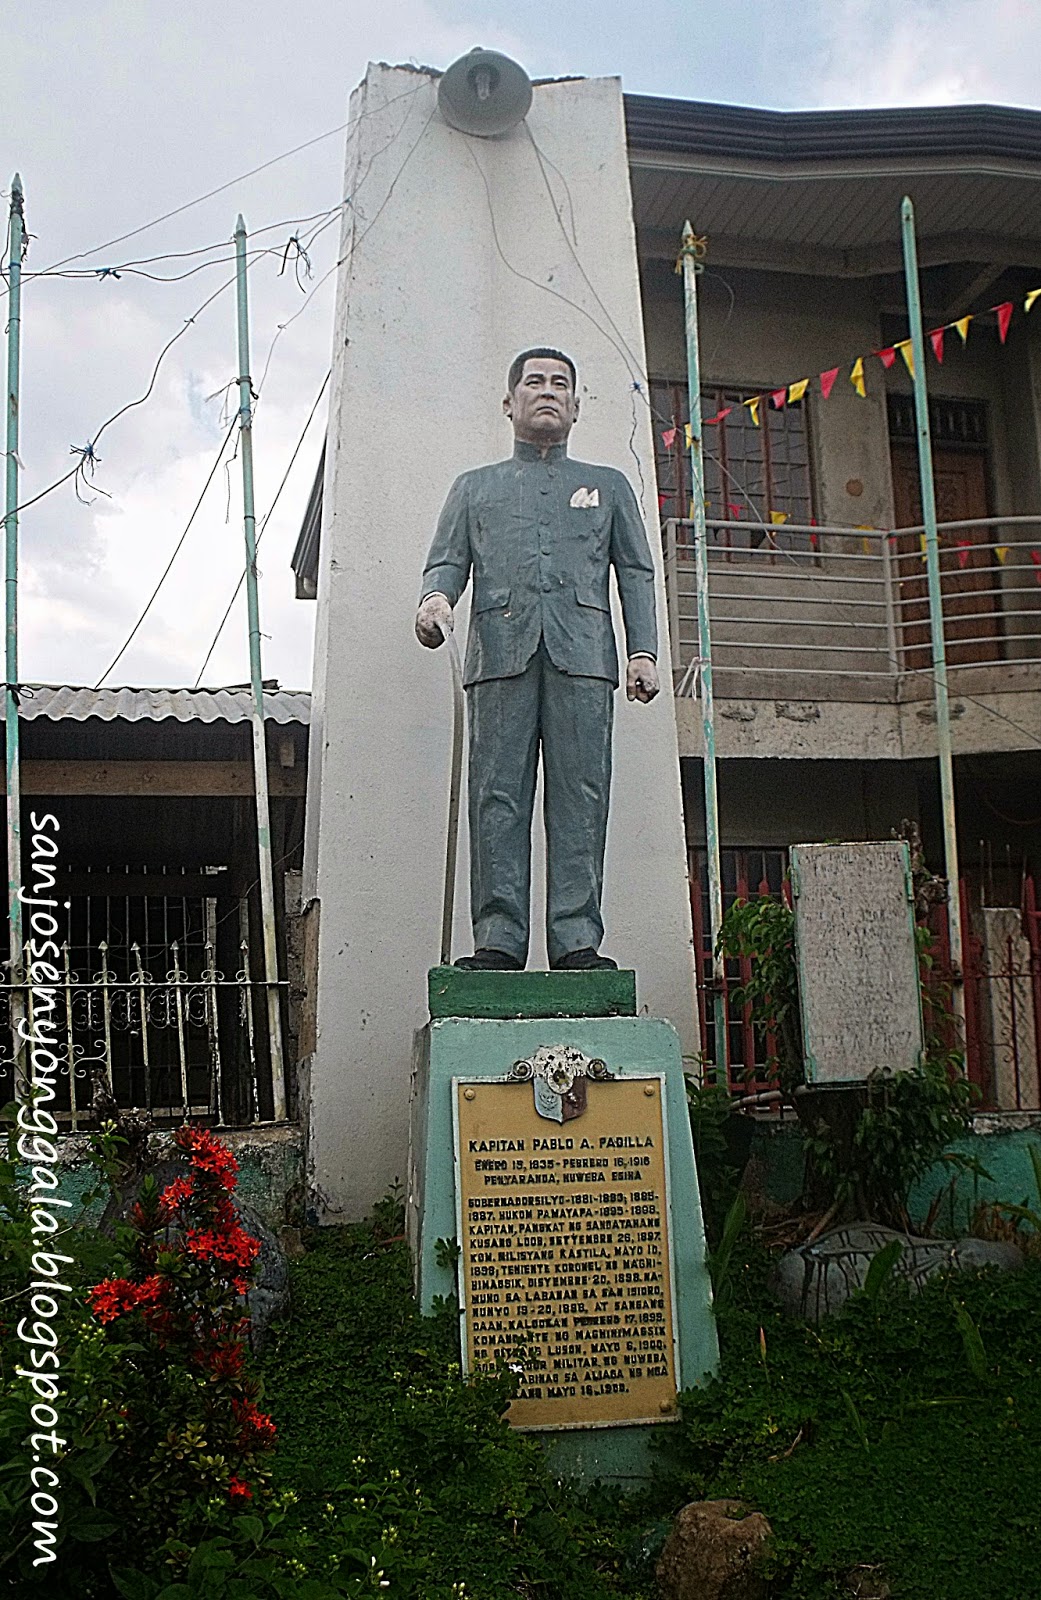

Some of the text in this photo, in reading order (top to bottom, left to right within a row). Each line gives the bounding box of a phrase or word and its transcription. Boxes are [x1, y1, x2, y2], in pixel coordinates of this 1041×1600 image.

[469, 1137, 654, 1152] KAPITAN PABLO A. PADILLA
[475, 1159, 507, 1171] ENERO
[563, 1172, 605, 1183] NUWEBA
[500, 1209, 532, 1220] HUKOM
[519, 1222, 564, 1233] PANGKAT
[569, 1222, 581, 1231] NG
[470, 1237, 512, 1248] KUSANG
[615, 1246, 643, 1256] MAYO
[501, 1264, 550, 1275] TENIENTE
[555, 1261, 600, 1273] KORONEL
[606, 1261, 617, 1270] NG
[506, 1292, 521, 1302] SA
[525, 1290, 578, 1302] LABANAN
[583, 1289, 597, 1298] SA
[602, 1287, 622, 1297] SAN
[595, 1302, 608, 1311] AT
[615, 1299, 664, 1310] SANGANG
[556, 1331, 569, 1341] NG
[474, 1348, 487, 1359] NG
[591, 1342, 620, 1353] MAYO
[604, 1356, 617, 1366] NG
[565, 1372, 578, 1382] SA
[629, 1368, 642, 1378] NG
[647, 1366, 668, 1377] MGA
[547, 1385, 575, 1397] MAYO
